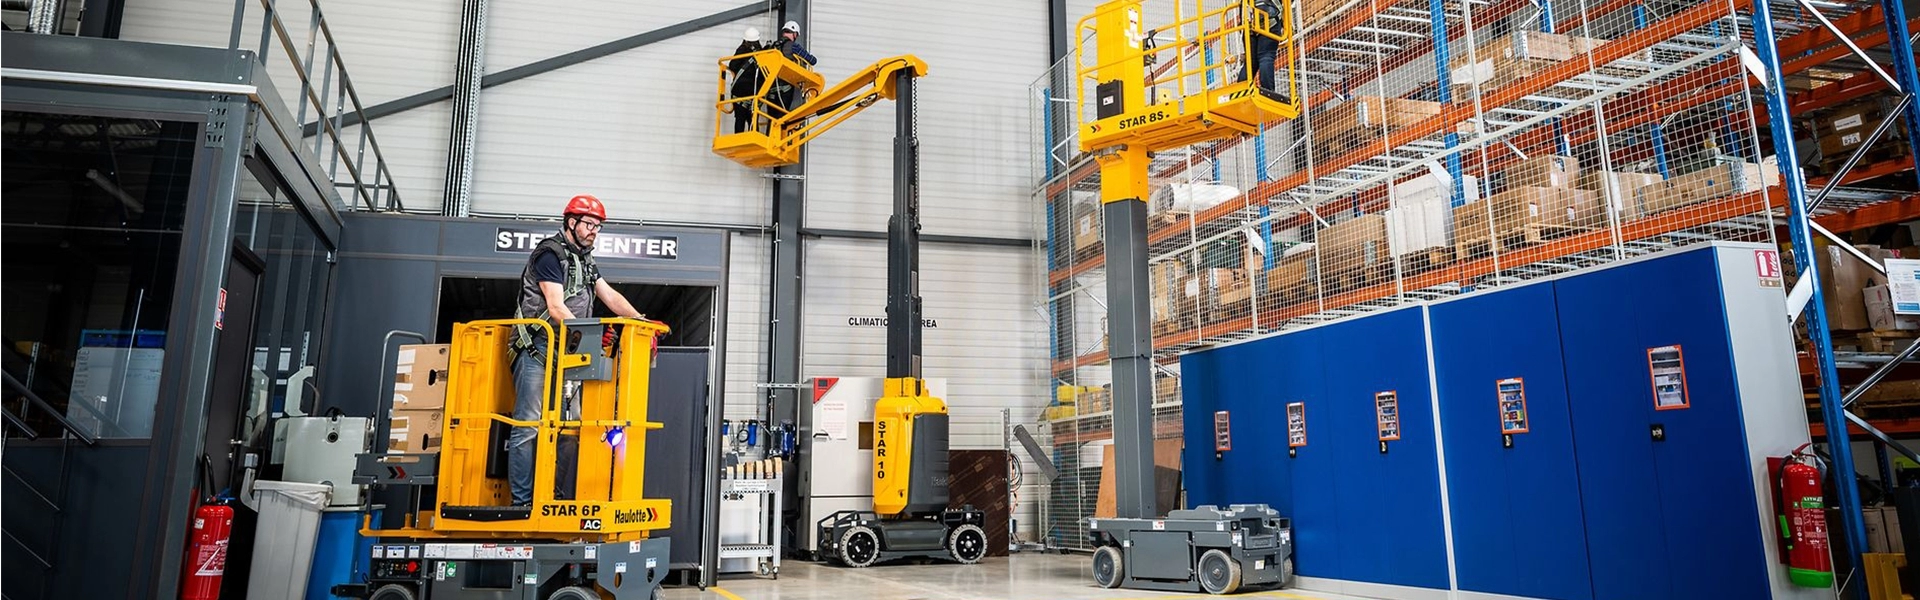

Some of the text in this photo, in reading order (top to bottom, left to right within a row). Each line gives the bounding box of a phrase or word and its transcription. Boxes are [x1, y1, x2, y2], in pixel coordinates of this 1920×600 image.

[1119, 111, 1164, 129] STAR 8S
[497, 231, 677, 256] STE ENTER
[921, 319, 937, 328] REA
[877, 421, 886, 479] STAR 10
[542, 505, 577, 516] STAR
[614, 509, 646, 524] Haulotte
[583, 519, 601, 530] AC
